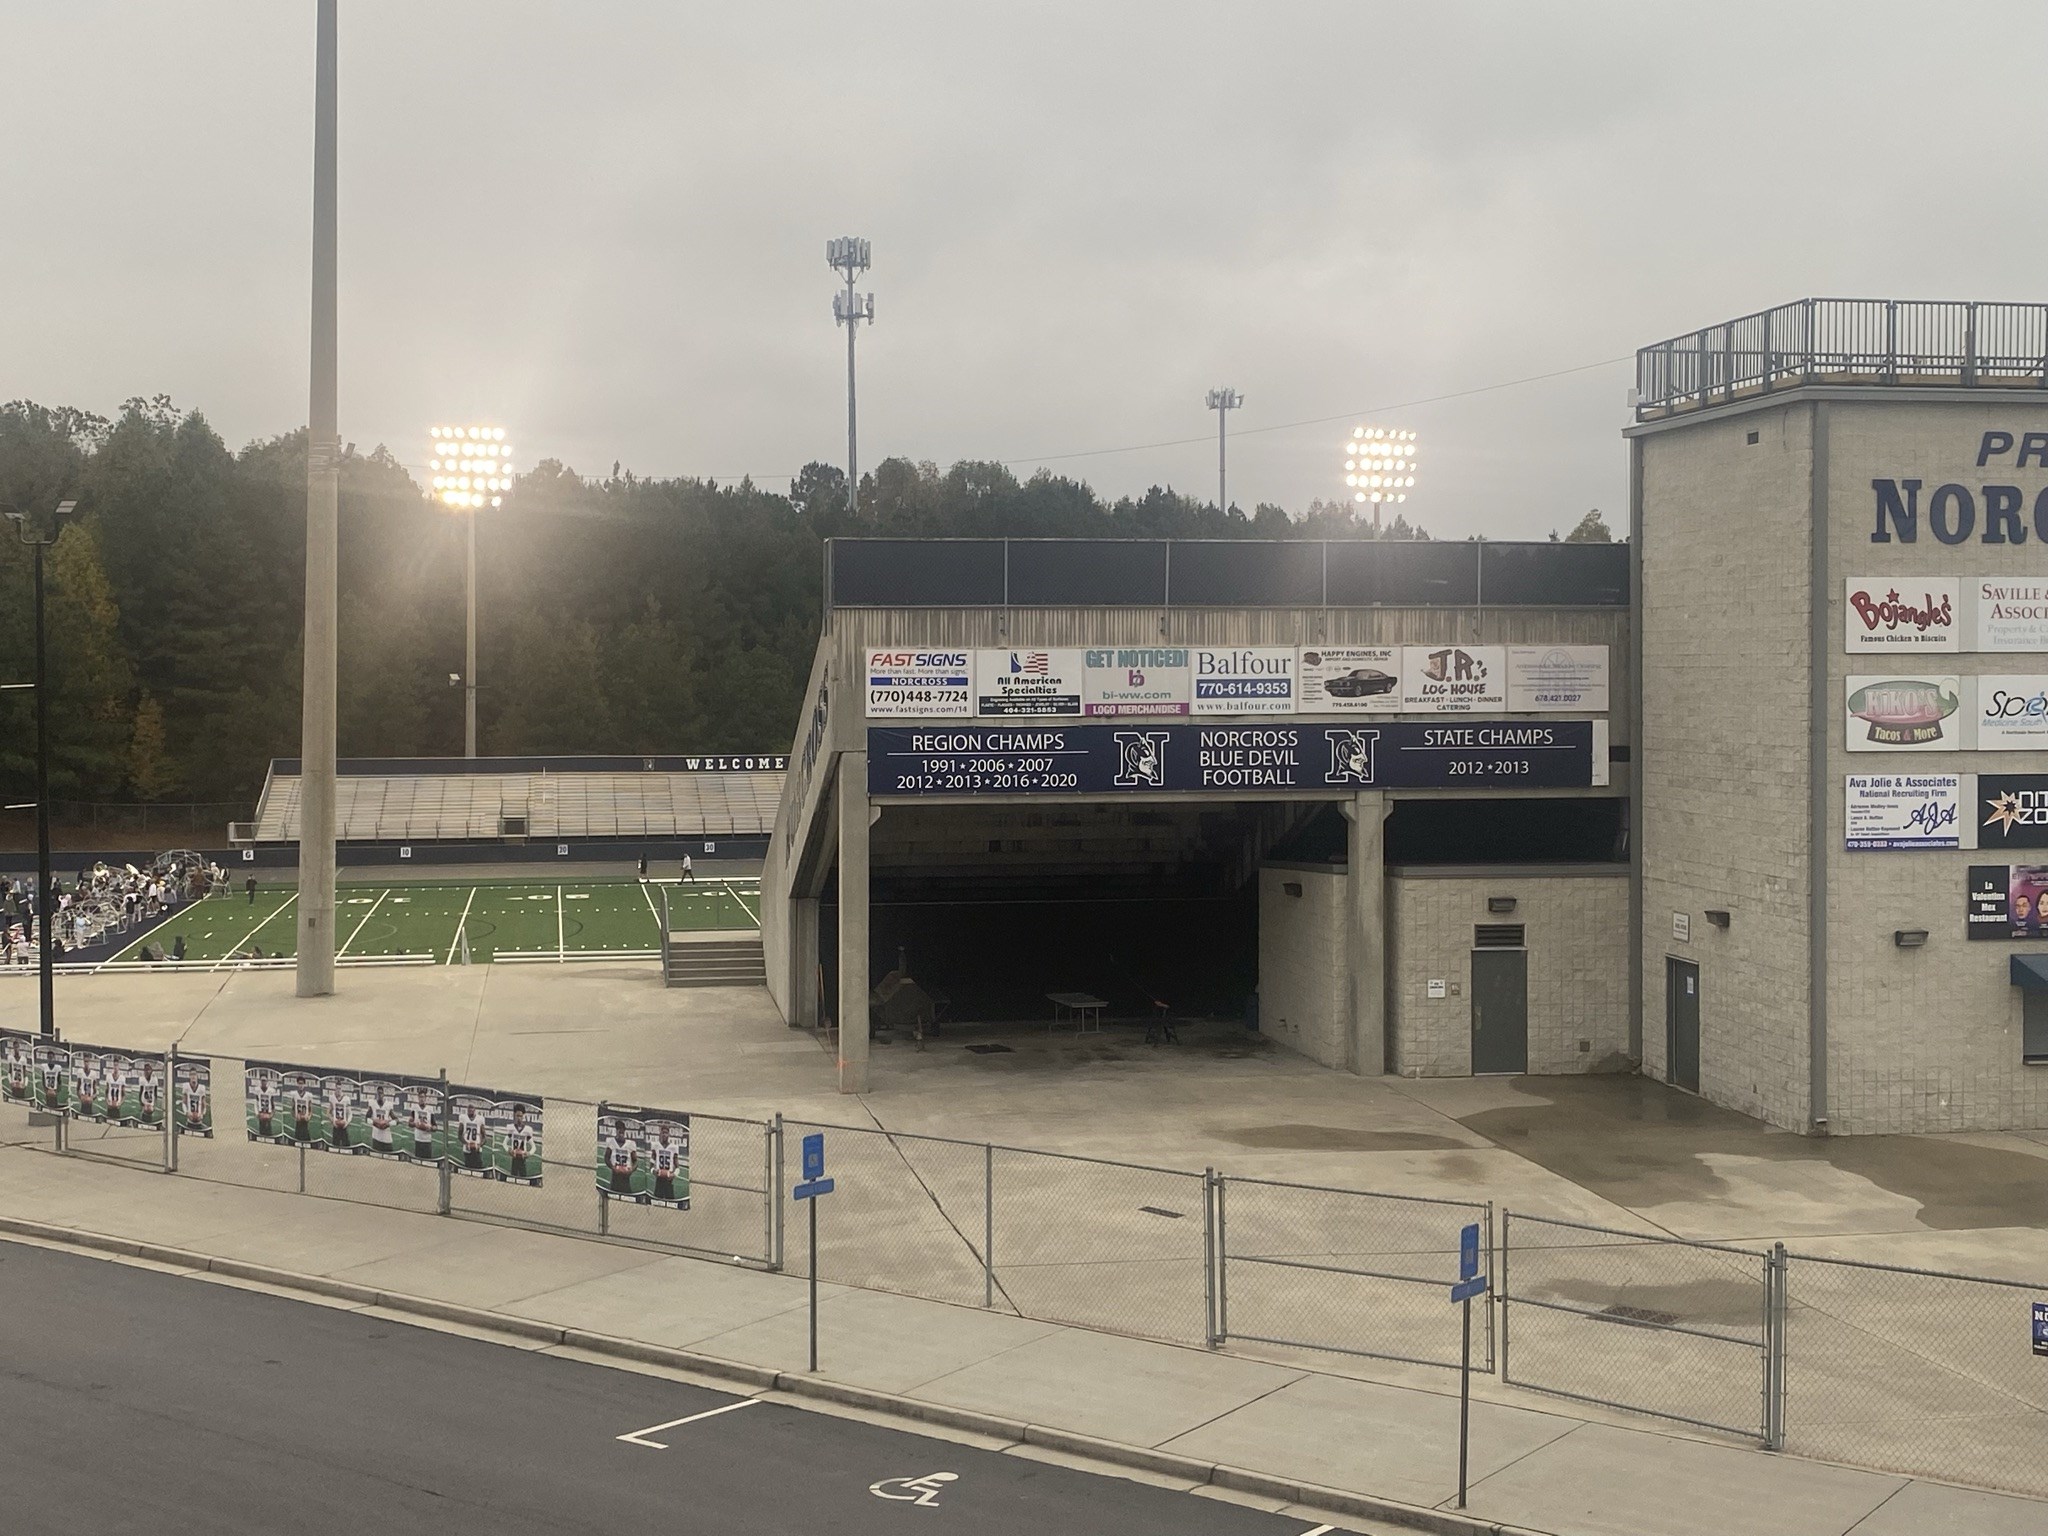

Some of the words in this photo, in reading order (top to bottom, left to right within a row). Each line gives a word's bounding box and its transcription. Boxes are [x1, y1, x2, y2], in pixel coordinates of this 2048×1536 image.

[1982, 583, 2041, 600] SAVILLE
[870, 653, 968, 667] FASTSIGNS
[1085, 650, 1114, 668] GET
[1117, 649, 1189, 668] NOTICED!
[1197, 651, 1291, 675] Balfour
[891, 678, 948, 686] NORCROSS
[997, 677, 1010, 685] All
[1014, 676, 1062, 685] American
[1002, 686, 1057, 697] Specialties
[1102, 691, 1171, 700] bi-ww.com
[1199, 682, 1288, 695] 770-614-9353
[1422, 684, 1448, 695] LOG
[1450, 683, 1486, 695] HOUSE
[870, 690, 968, 704] (770)448-7724
[870, 705, 968, 714] www.fastsigns.com/14
[1093, 705, 1116, 714] LOGO
[1118, 704, 1181, 714] MERCHANDISE
[1197, 701, 1291, 711] www.balfour.com
[1200, 730, 1298, 747] NORCROSS
[1424, 729, 1474, 746] STATE
[1478, 728, 1553, 745] CHAMPS
[1874, 726, 1901, 741] Tacos
[1913, 726, 1938, 740] More
[912, 734, 981, 751] REGION
[986, 733, 1065, 750] CHAMPS
[685, 758, 784, 770] WELCOME
[1200, 750, 1244, 767] BLUE
[1249, 749, 1299, 766] DEVIL
[921, 759, 956, 773] 1991
[968, 759, 1005, 773] 2006
[1017, 758, 1053, 772] 2007
[1449, 761, 1484, 775] 2012
[1494, 761, 1529, 774] 2013
[897, 775, 934, 789] 2012
[945, 775, 982, 788] 2013
[993, 774, 1030, 788] 2016
[1041, 773, 1077, 787] 2020
[1203, 769, 1296, 786] FOOTBALL
[1849, 778, 1867, 788] Ava
[1870, 778, 1892, 787] Jolie
[1895, 778, 1902, 787] &
[1905, 777, 1957, 787] Associates
[1859, 790, 1890, 798] National
[1892, 789, 1930, 799] Recruiting
[1931, 789, 1947, 797] Firm
[402, 848, 410, 856] 10
[466, 1127, 478, 1141] 78
[658, 1155, 671, 1169] 95
